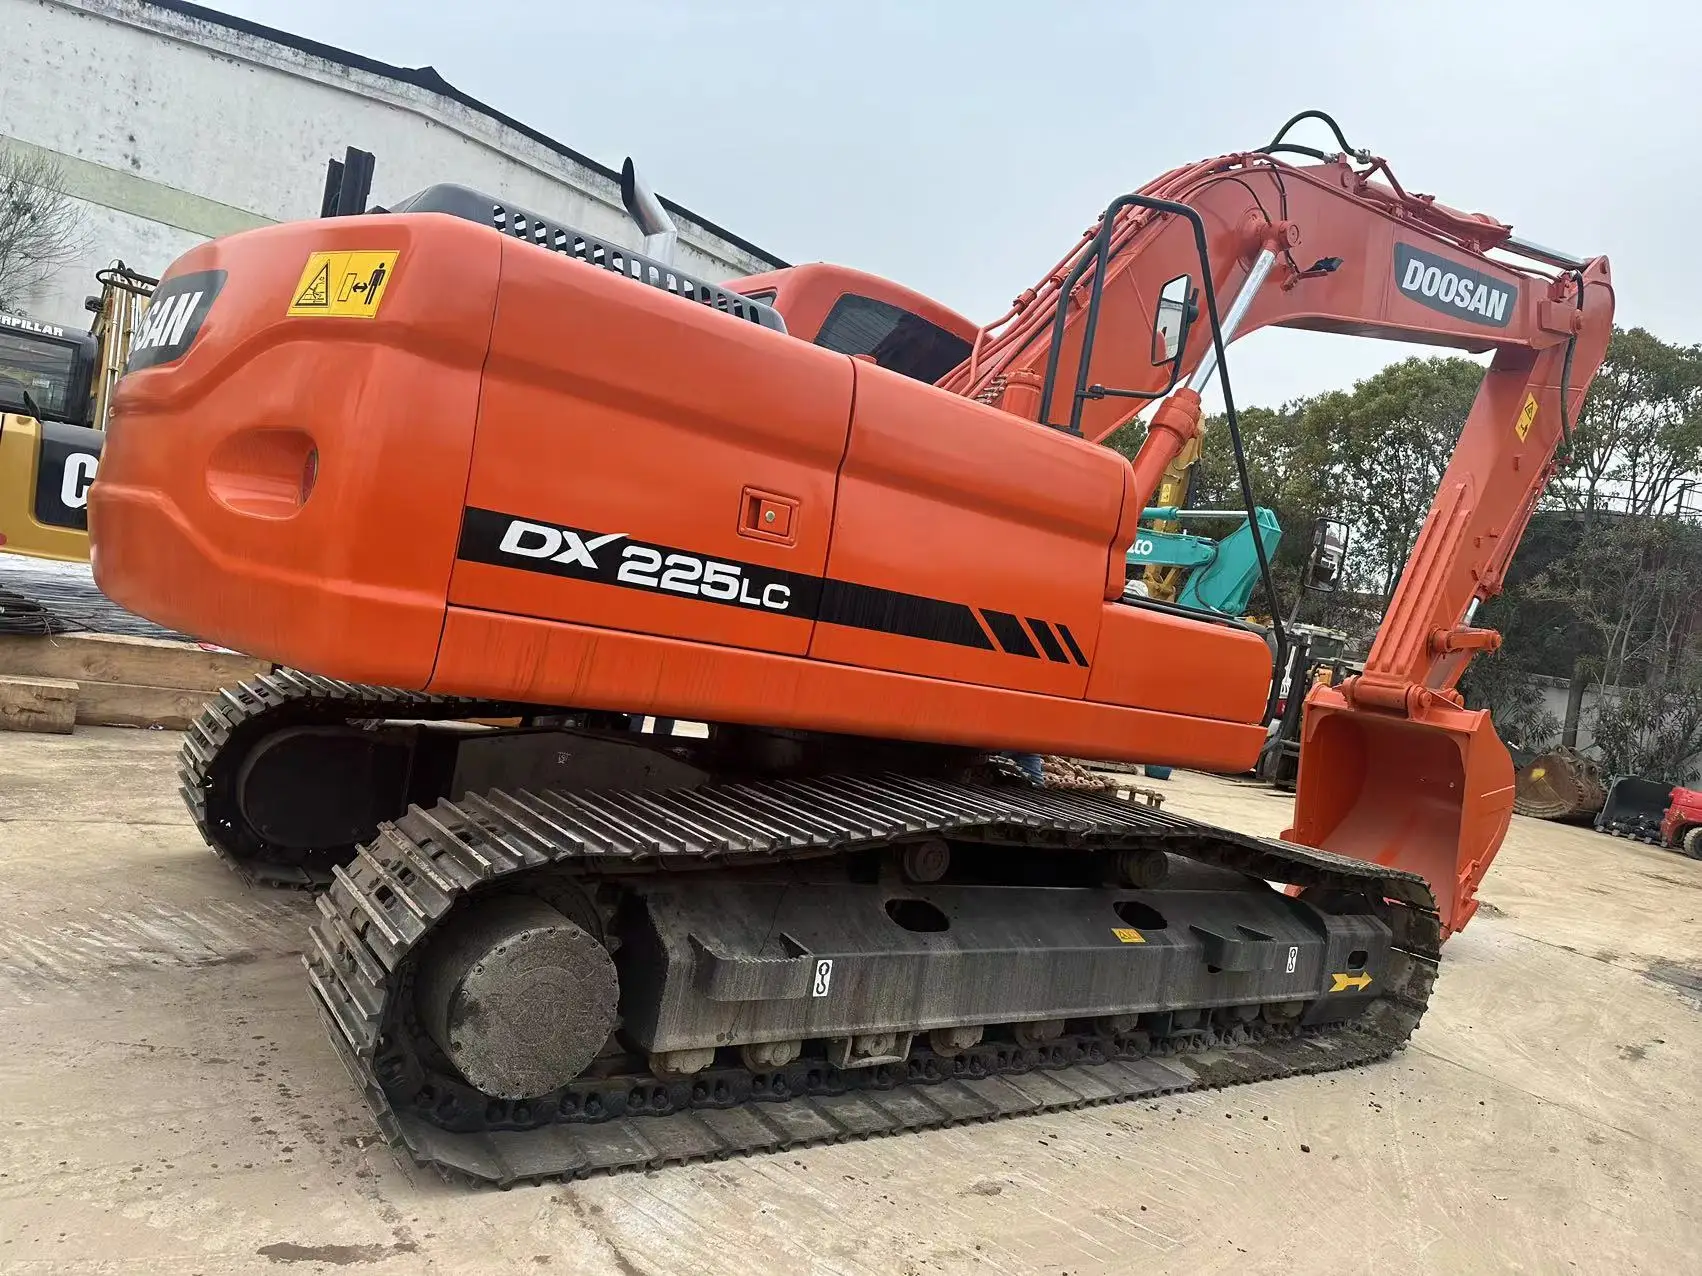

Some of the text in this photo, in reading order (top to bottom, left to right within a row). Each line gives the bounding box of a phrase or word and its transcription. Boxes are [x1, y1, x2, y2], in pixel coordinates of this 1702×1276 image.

[1402, 258, 1508, 321] DOOSAN
[0, 315, 64, 337] RPILLAR
[134, 291, 204, 351] SAN
[499, 520, 791, 610] DX 225LC
